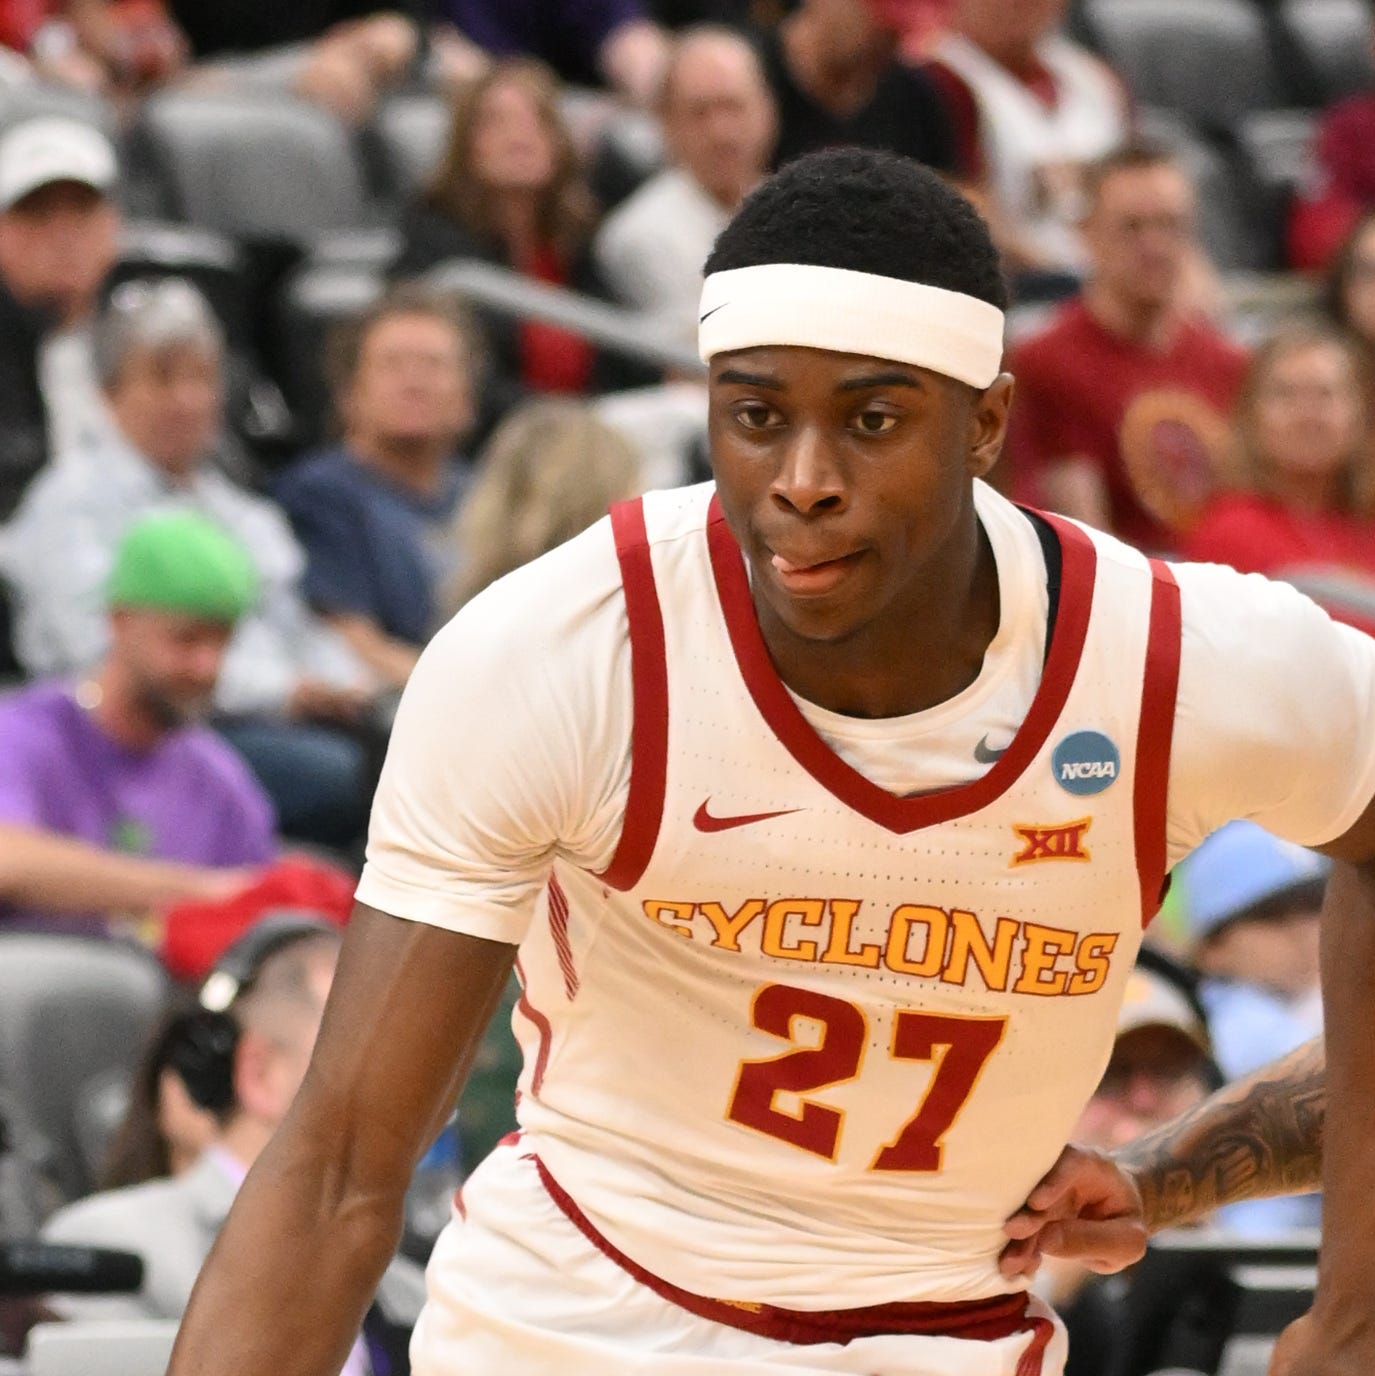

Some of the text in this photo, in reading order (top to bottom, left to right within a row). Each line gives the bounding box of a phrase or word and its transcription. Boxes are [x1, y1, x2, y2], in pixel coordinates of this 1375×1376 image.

[1061, 761, 1116, 781] NCAA
[1010, 818, 1092, 867] XII
[725, 981, 1010, 1173] 27
